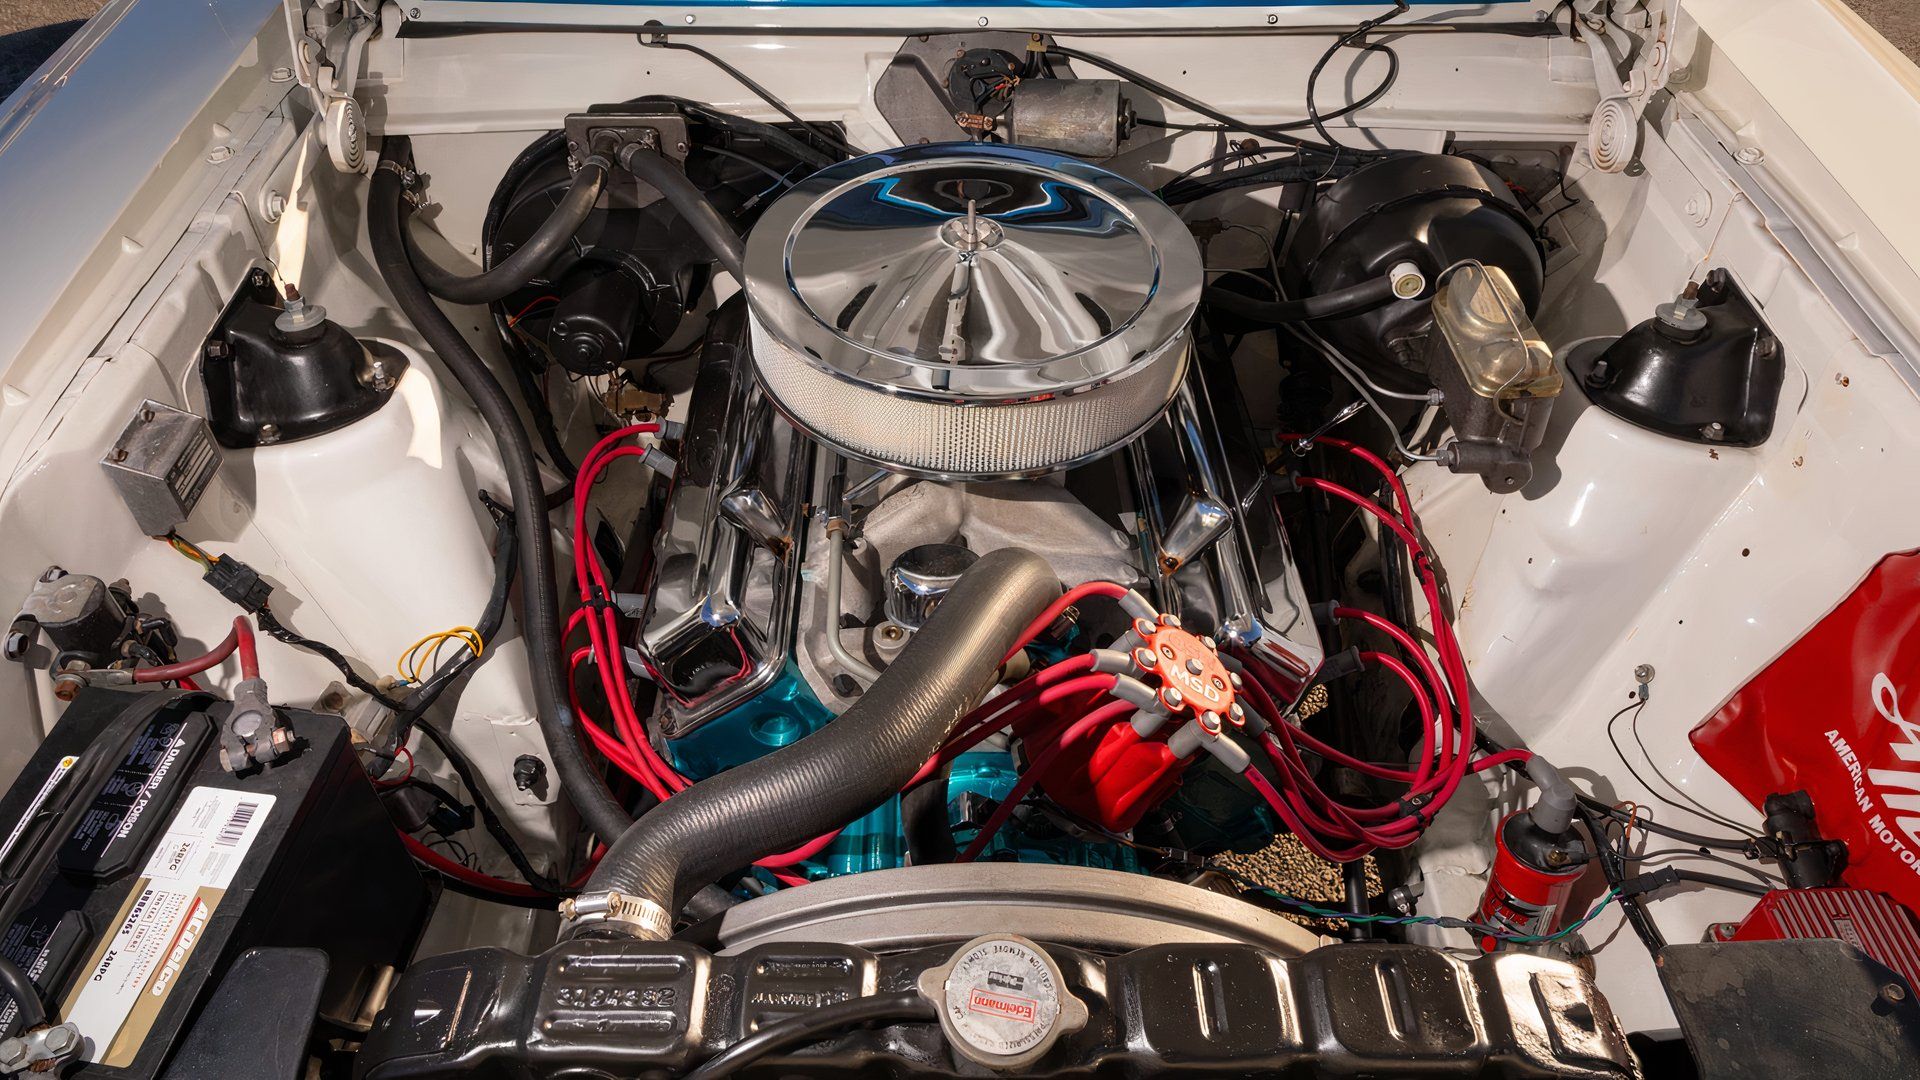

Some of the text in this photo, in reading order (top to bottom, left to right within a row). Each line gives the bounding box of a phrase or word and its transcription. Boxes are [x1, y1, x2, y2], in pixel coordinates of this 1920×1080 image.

[1170, 664, 1219, 703] MSD
[148, 748, 180, 790] DANGER
[1824, 729, 1873, 813] AMERICAN
[117, 799, 148, 839] POISON
[151, 900, 208, 996] ACDelco
[974, 995, 1032, 1019] Edelmann
